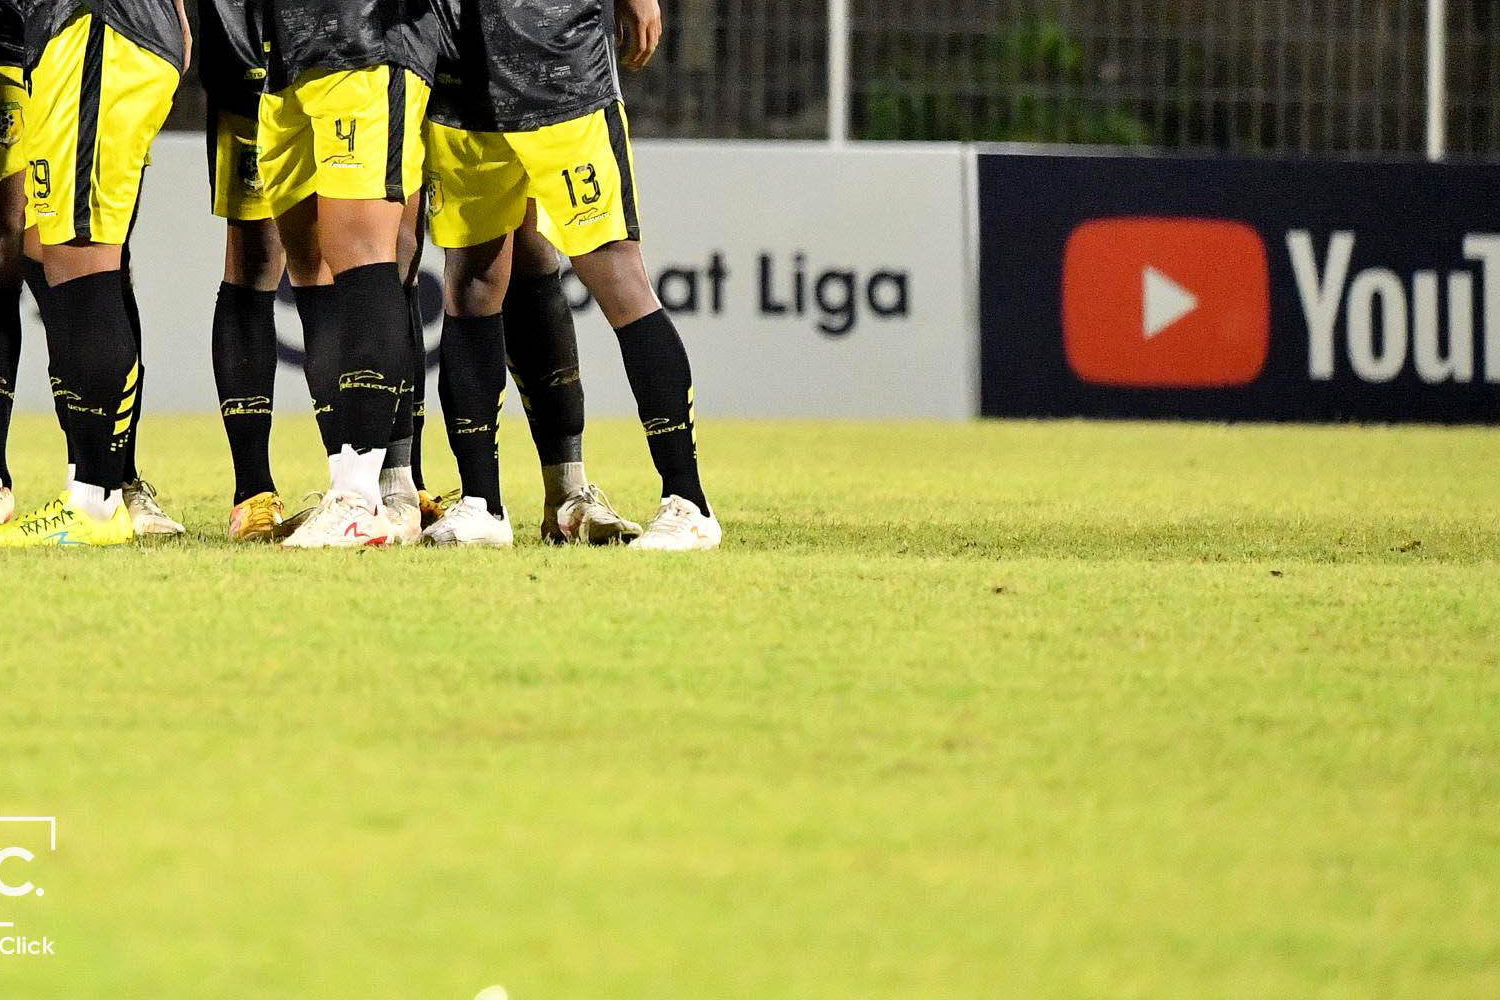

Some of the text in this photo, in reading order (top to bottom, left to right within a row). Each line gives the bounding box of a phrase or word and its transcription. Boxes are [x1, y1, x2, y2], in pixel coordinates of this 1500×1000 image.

[335, 118, 357, 153] 4
[562, 163, 601, 208] 13
[759, 252, 910, 338] Liga
[1286, 230, 1500, 384] YouT
